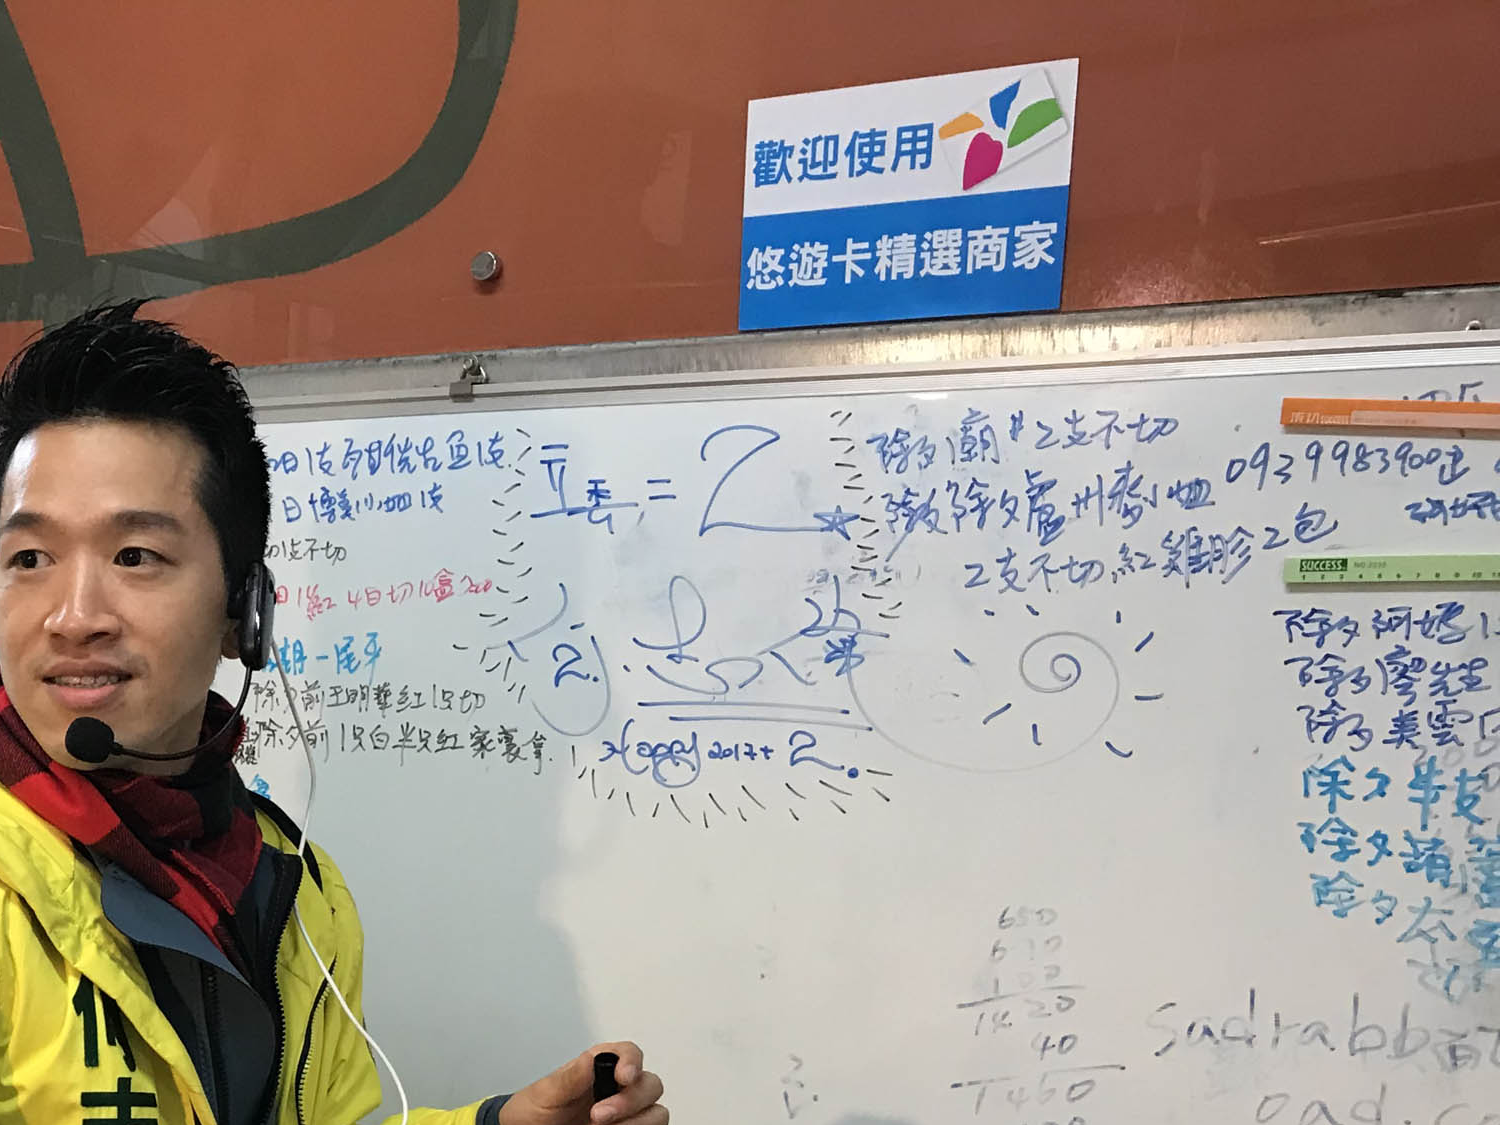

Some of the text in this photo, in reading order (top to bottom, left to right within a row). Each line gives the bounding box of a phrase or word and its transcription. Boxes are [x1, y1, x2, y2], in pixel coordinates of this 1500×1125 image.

[752, 121, 934, 189] 歡迎使用
[745, 220, 1058, 291] 悠遊卡精選商家
[1301, 559, 1347, 571] SUCCESS
